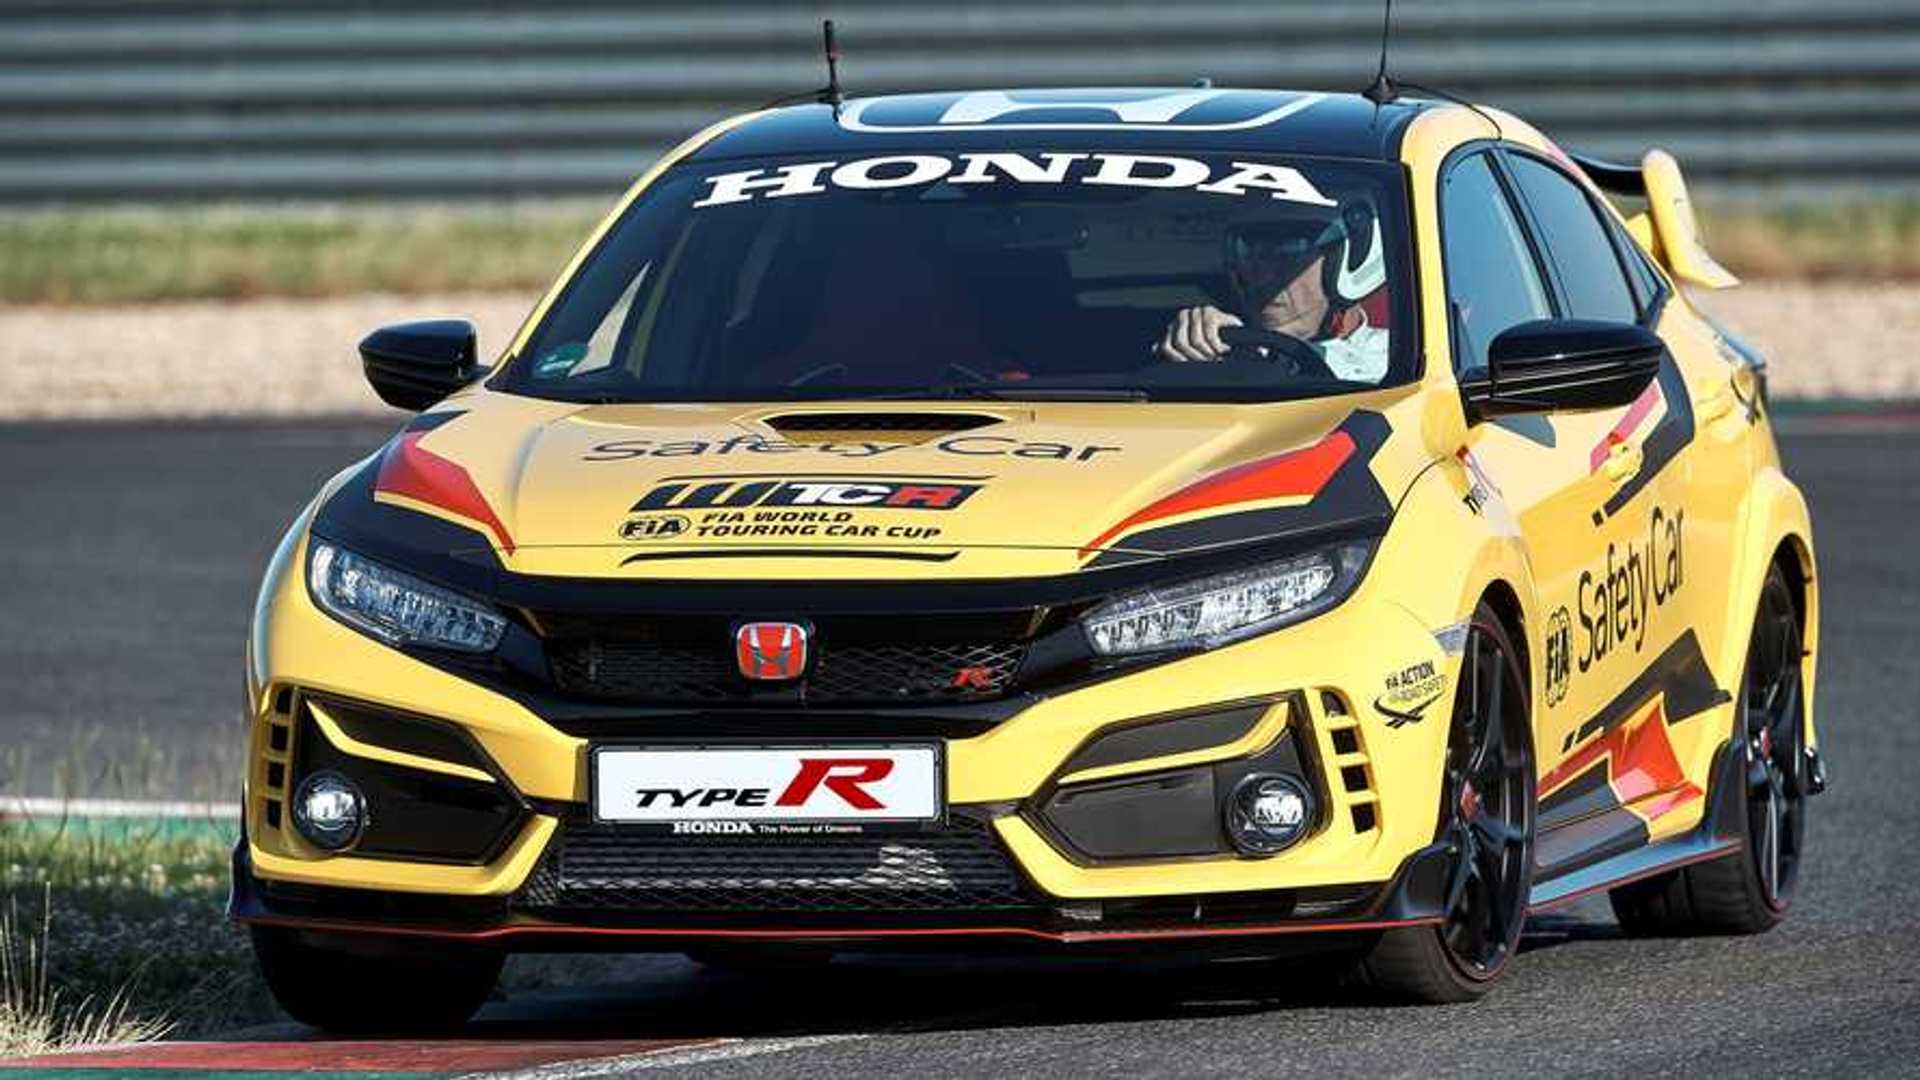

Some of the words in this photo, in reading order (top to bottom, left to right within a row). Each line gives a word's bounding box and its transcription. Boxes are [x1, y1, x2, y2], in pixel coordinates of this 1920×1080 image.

[693, 153, 1338, 207] HONDA
[938, 436, 1123, 461] Car
[629, 482, 968, 512] WTCR
[623, 520, 682, 537] FIA
[702, 511, 745, 523] FIA
[753, 511, 853, 523] WORLD
[697, 524, 826, 537] TOURING
[832, 525, 878, 537] CAR
[886, 526, 941, 539] CUP
[1578, 542, 1649, 673] Safety
[1651, 506, 1684, 606] Car
[1546, 624, 1571, 692] FIA
[1401, 659, 1435, 686] ACTION
[635, 788, 771, 808] TYPE
[774, 758, 895, 811] R
[673, 821, 755, 834] HONDA
[759, 825, 778, 834] The
[779, 825, 810, 834] Power
[812, 825, 823, 834] of
